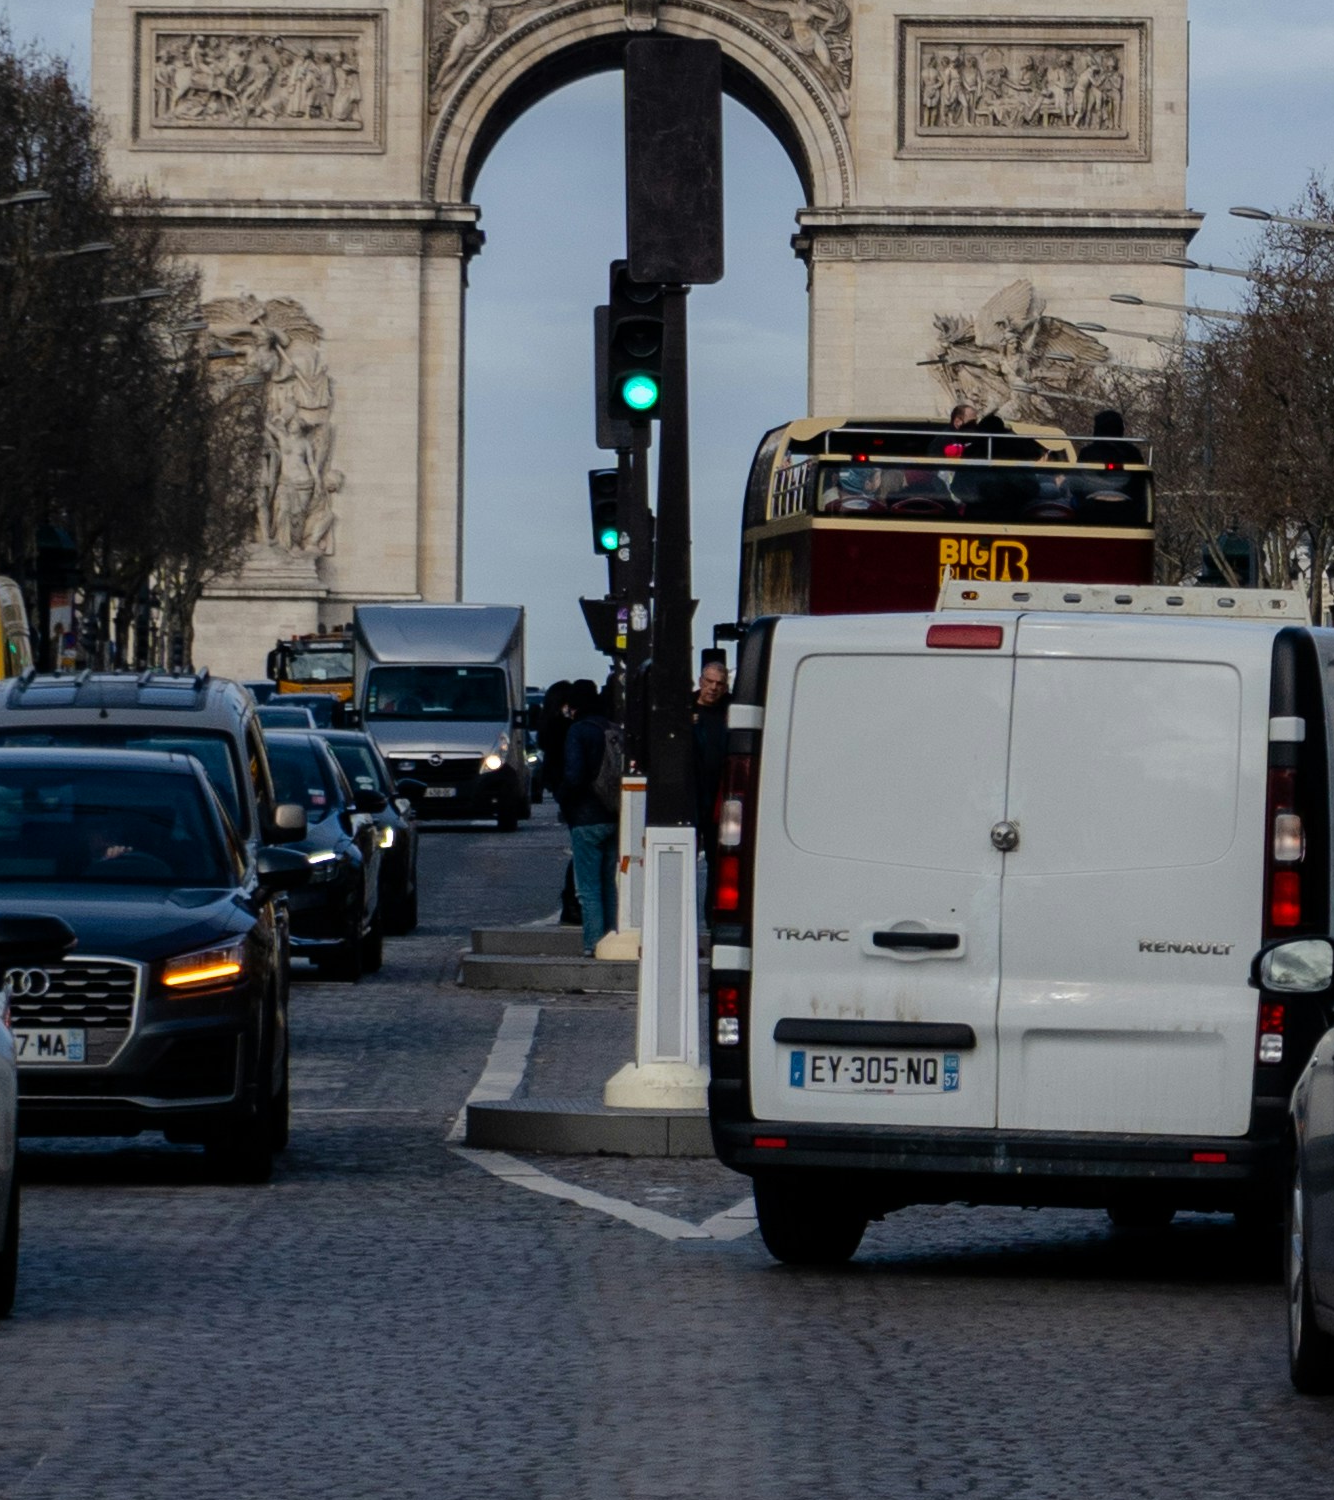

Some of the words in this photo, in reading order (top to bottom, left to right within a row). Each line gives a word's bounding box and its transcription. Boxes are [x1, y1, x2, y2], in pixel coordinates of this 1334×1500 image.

[939, 538, 990, 566] BIG
[772, 927, 850, 941] TRAFIC
[1138, 940, 1235, 955] RENAULT
[15, 1034, 66, 1056] 7-MA
[810, 1055, 938, 1085] EY-305-NQ
[944, 1072, 959, 1087] 57
